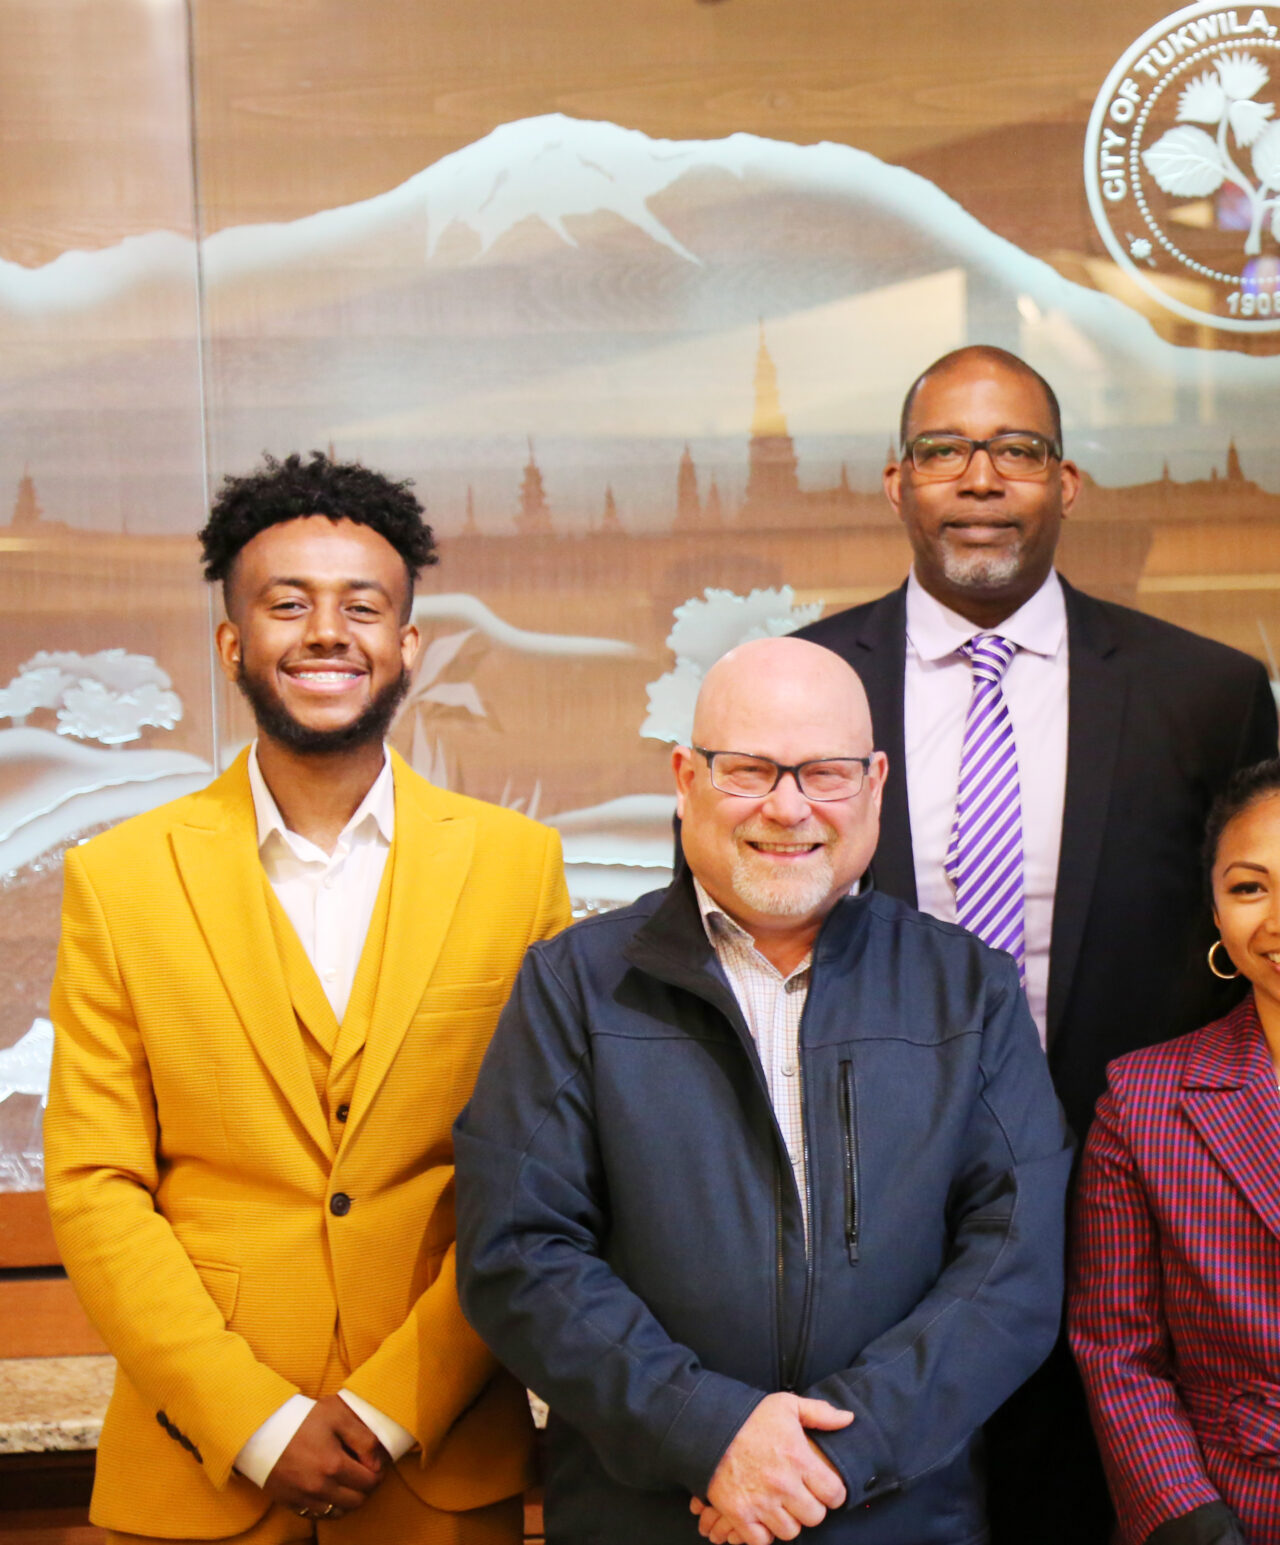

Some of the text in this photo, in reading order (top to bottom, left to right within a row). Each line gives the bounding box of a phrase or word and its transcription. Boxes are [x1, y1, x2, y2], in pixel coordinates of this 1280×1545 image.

[1134, 9, 1278, 79] TUKWILA,
[1110, 78, 1142, 124] OF
[1101, 128, 1127, 202] CITY
